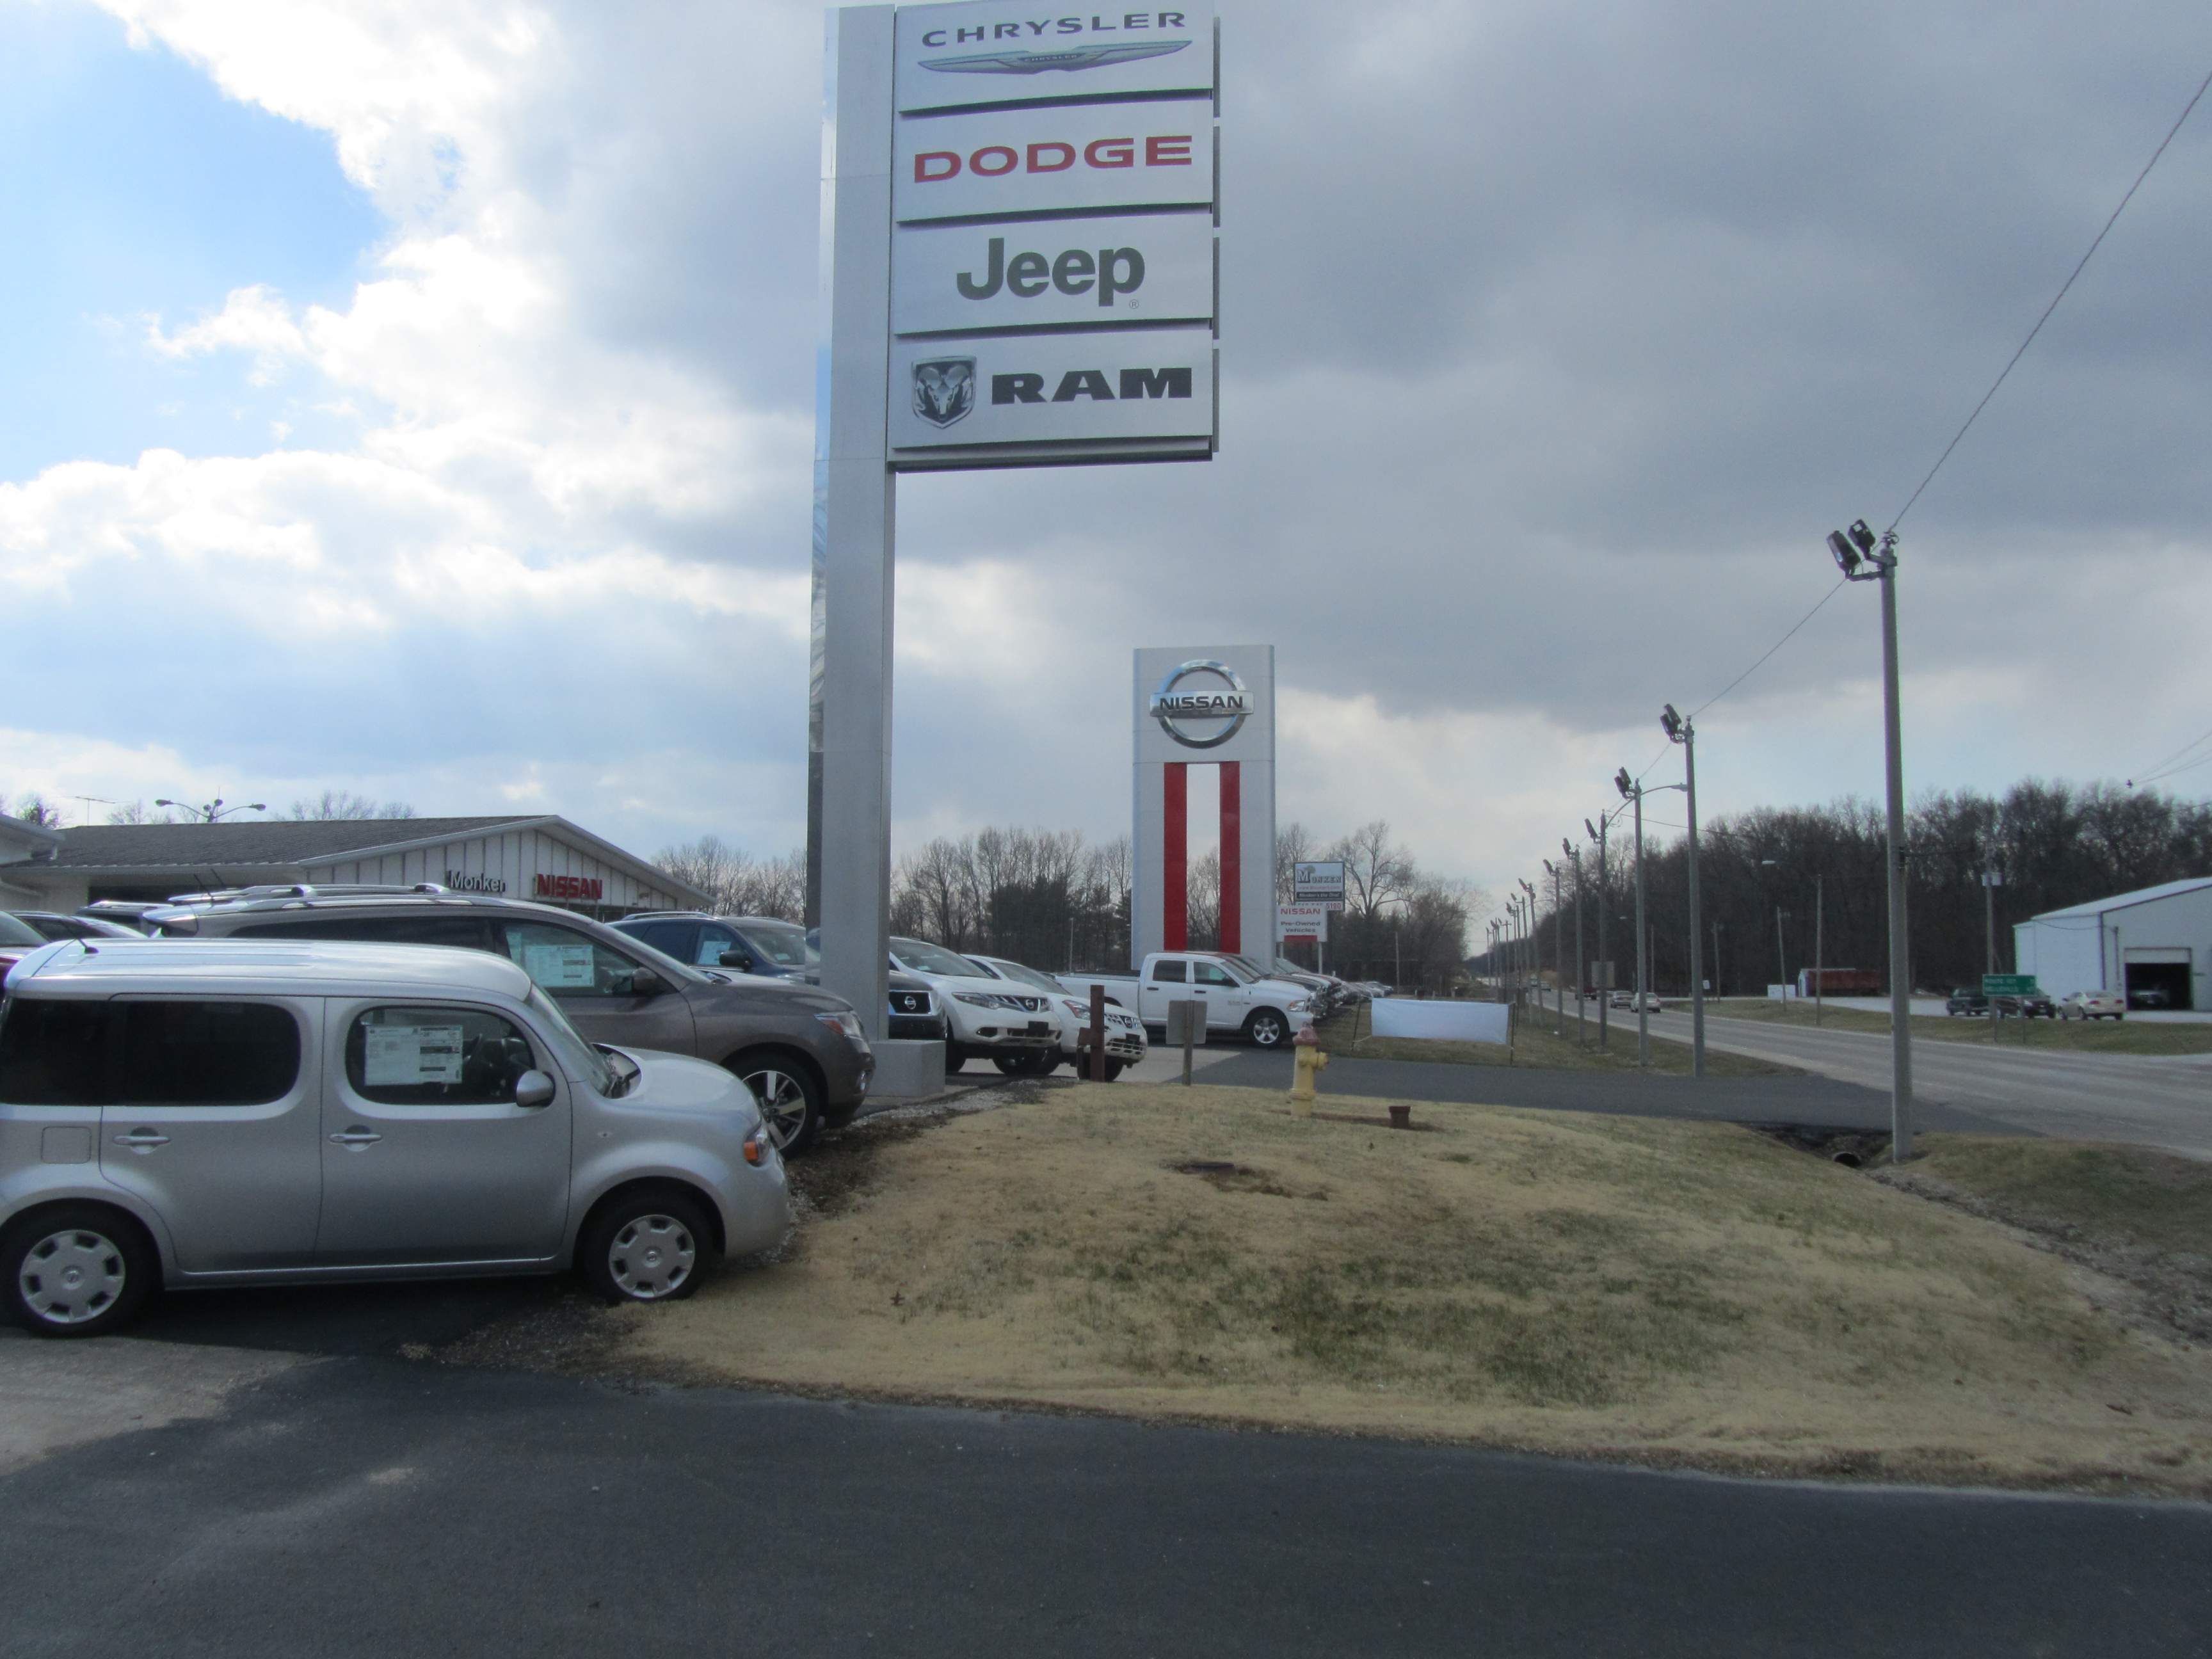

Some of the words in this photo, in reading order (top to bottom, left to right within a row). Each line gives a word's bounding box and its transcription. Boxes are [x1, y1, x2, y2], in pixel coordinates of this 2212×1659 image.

[922, 12, 1185, 47] CHRYSLER
[914, 135, 1192, 183] DODGE
[956, 237, 1145, 307] Jeep
[992, 367, 1192, 405] RAM
[1159, 696, 1243, 710] NISSAN
[448, 870, 506, 892] Monken
[536, 874, 602, 899] NISSAN
